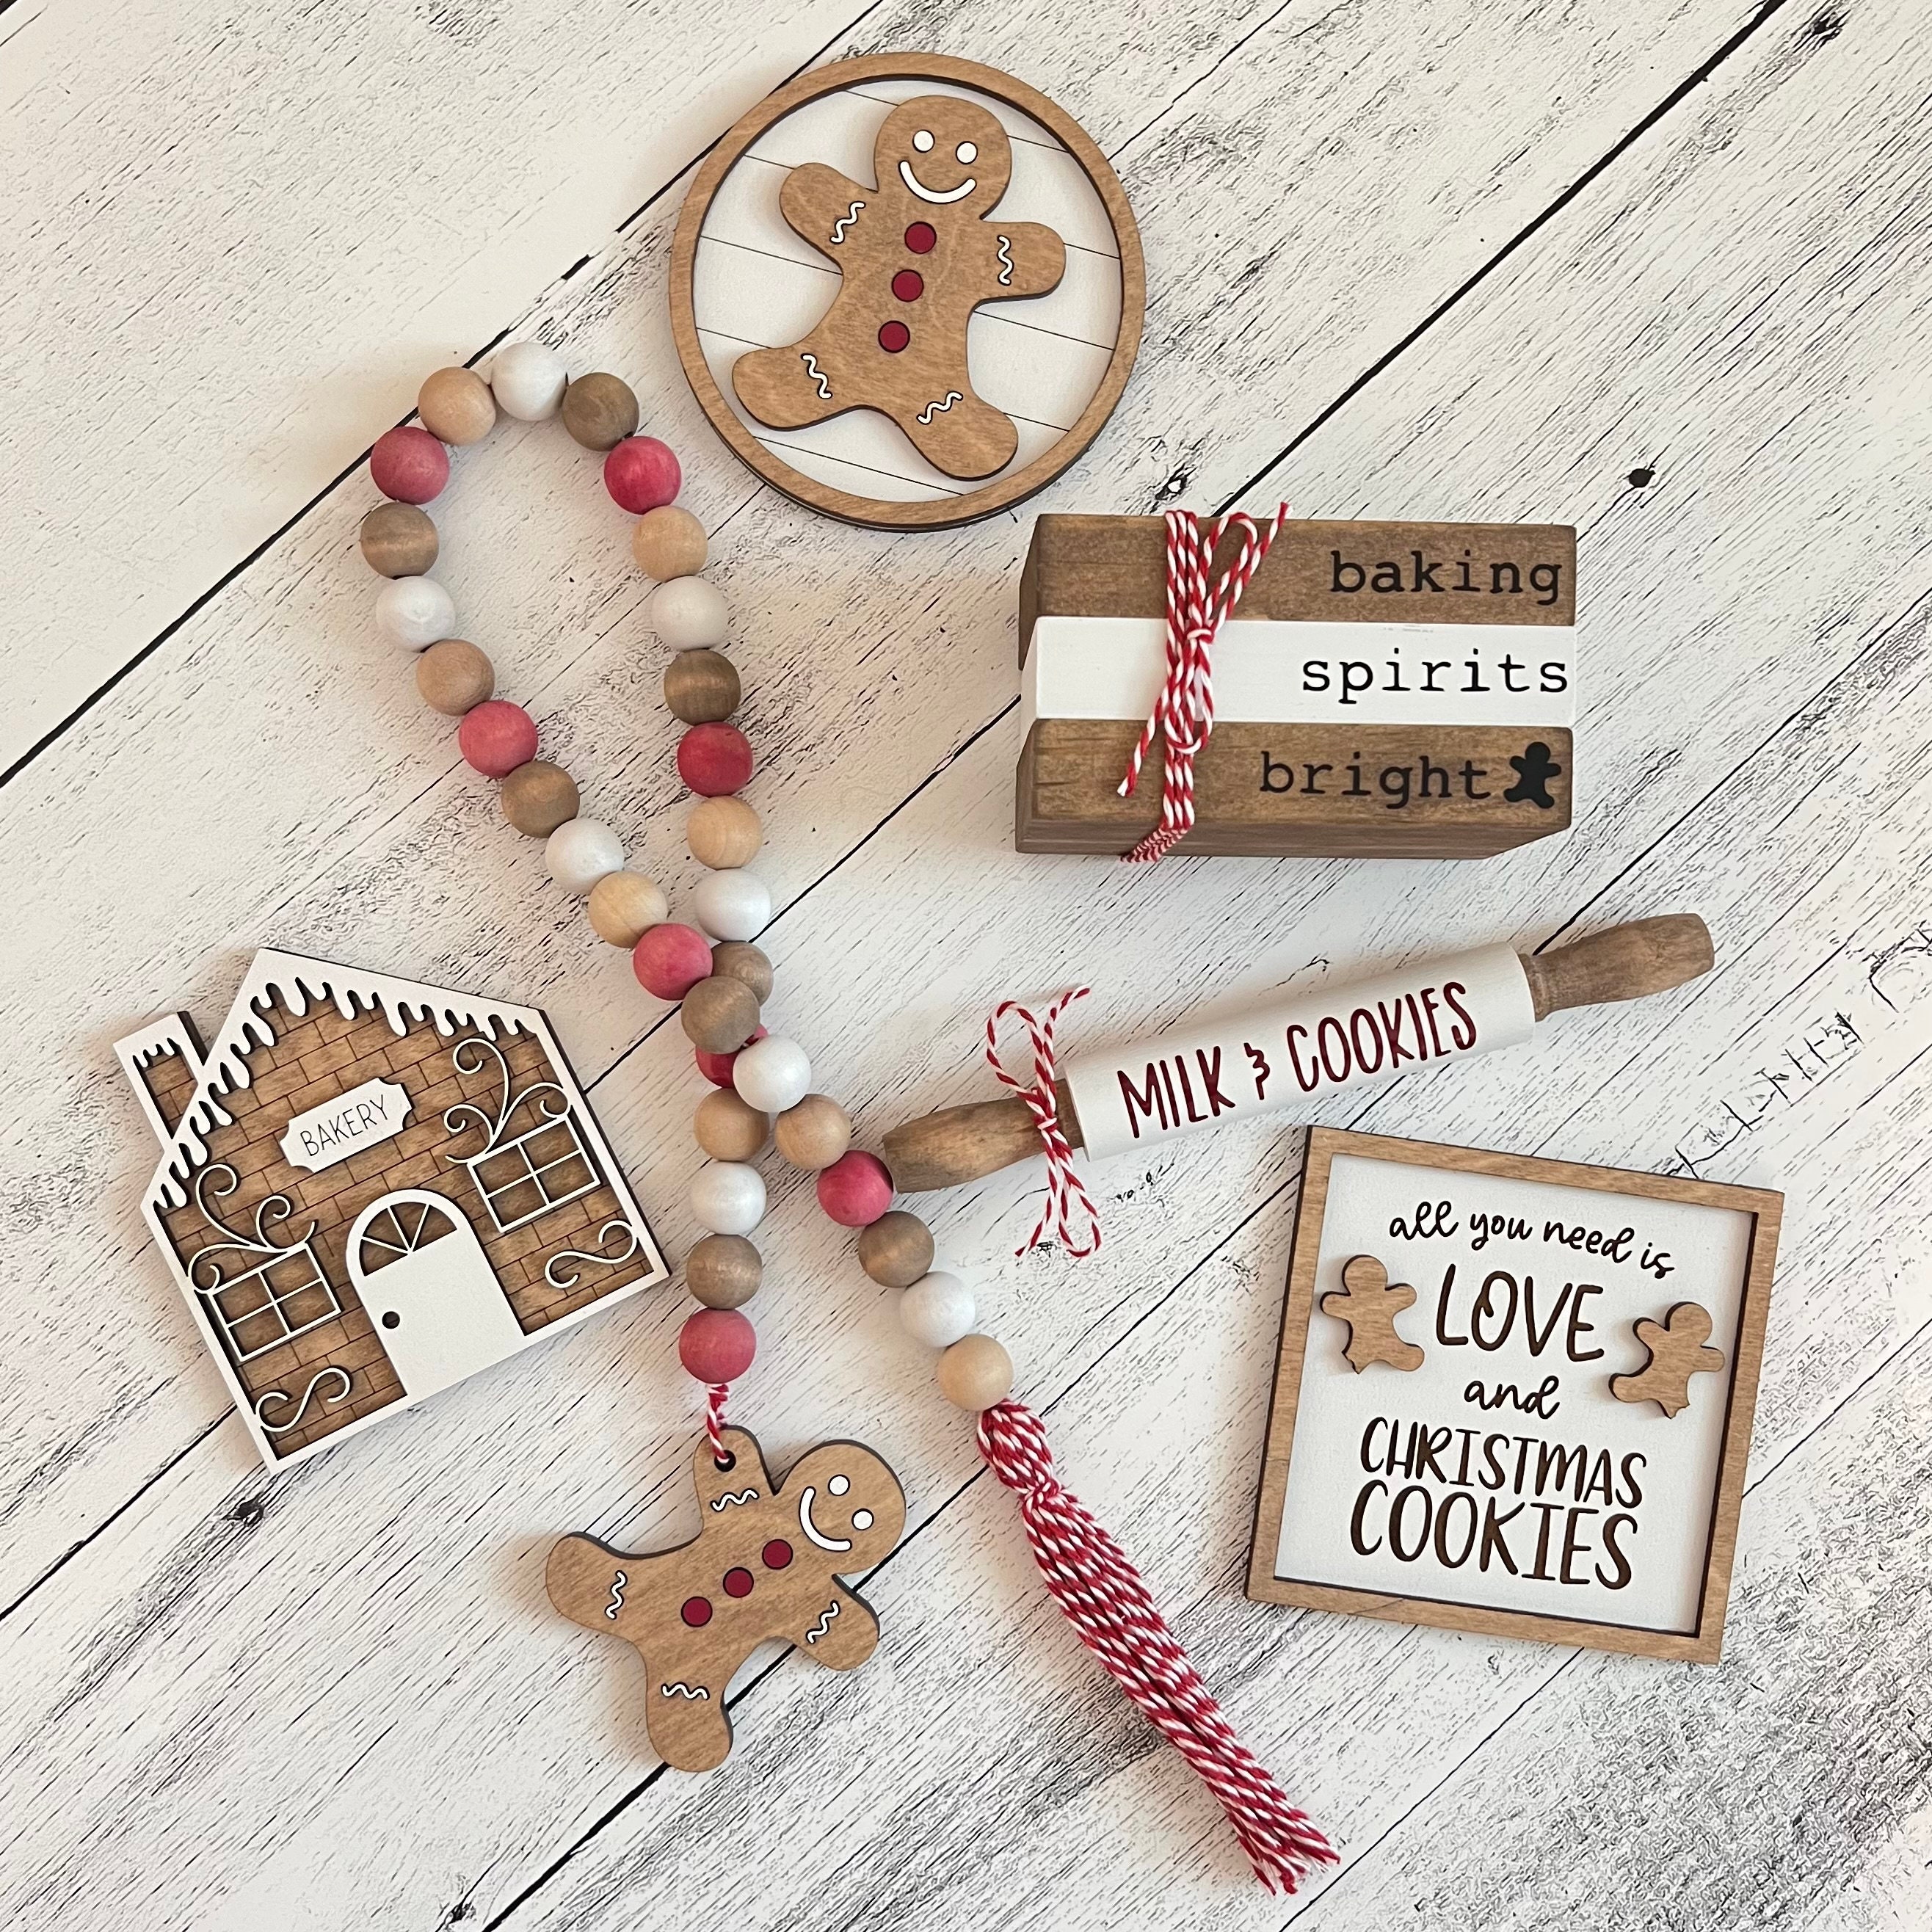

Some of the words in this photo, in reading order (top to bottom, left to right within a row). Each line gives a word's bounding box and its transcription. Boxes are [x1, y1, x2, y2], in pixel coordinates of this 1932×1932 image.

[1330, 549, 1562, 606] baking
[1302, 647, 1568, 705] spirits
[1260, 750, 1492, 810] bright
[1116, 1046, 1236, 1138] MILK
[1286, 982, 1477, 1092] COOKIES
[299, 1094, 388, 1157] BAKERY
[1390, 1200, 1459, 1241] all
[1470, 1213, 1533, 1249] you
[1543, 1219, 1634, 1263] need
[1641, 1241, 1675, 1279] is
[1435, 1263, 1605, 1362] LOVE
[1464, 1376, 1561, 1420] and
[1360, 1417, 1647, 1509] CHRISTMAS
[1350, 1479, 1638, 1591] COOKIES
